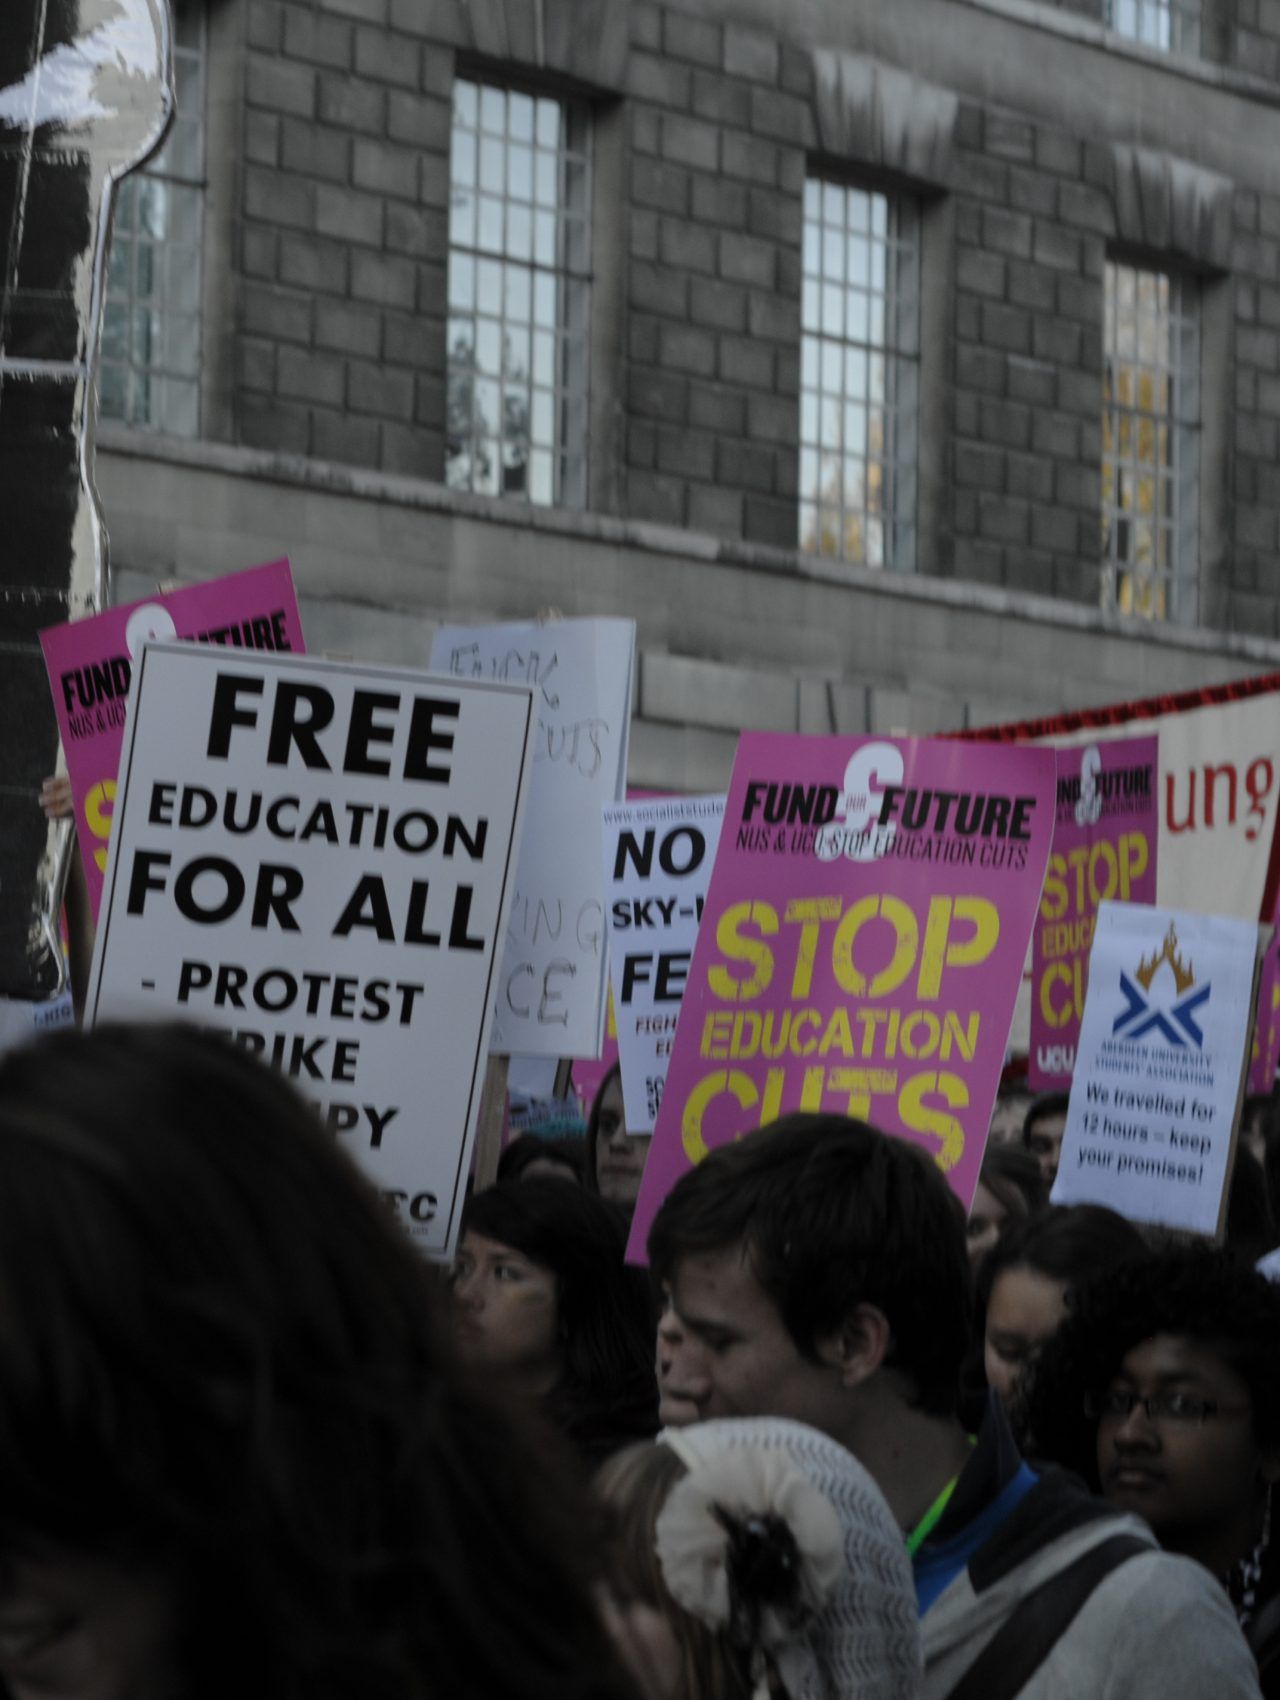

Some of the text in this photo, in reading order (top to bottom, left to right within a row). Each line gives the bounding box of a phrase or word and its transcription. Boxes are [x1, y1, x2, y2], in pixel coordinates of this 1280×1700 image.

[61, 657, 132, 712] FUND
[67, 709, 95, 741] NUS
[206, 672, 460, 785] FREE
[1094, 764, 1152, 800] FUTURE
[148, 782, 488, 859] EDUCATION
[742, 782, 839, 826] FUND
[878, 785, 1036, 841] FUTURE
[613, 826, 706, 881] NO
[736, 826, 769, 850] NUS
[774, 830, 785, 850] &
[831, 830, 868, 858] STOP
[873, 832, 973, 866] EDUCATION
[980, 840, 1029, 872] CUTS
[126, 849, 486, 951] FOR ALL
[612, 895, 705, 929] SKY-
[707, 894, 1001, 1002] STOP
[177, 961, 424, 1026] PROTEST
[699, 1006, 981, 1063] EDUCATION
[1151, 1046, 1212, 1069] UNIVERSITY
[1146, 1064, 1214, 1088] ASSOCIATION
[1086, 1080, 1215, 1124] We travelled for
[1083, 1111, 1099, 1135] 12
[1103, 1114, 1149, 1143] hours
[1170, 1125, 1212, 1157] keep
[1077, 1145, 1204, 1185] your promises!
